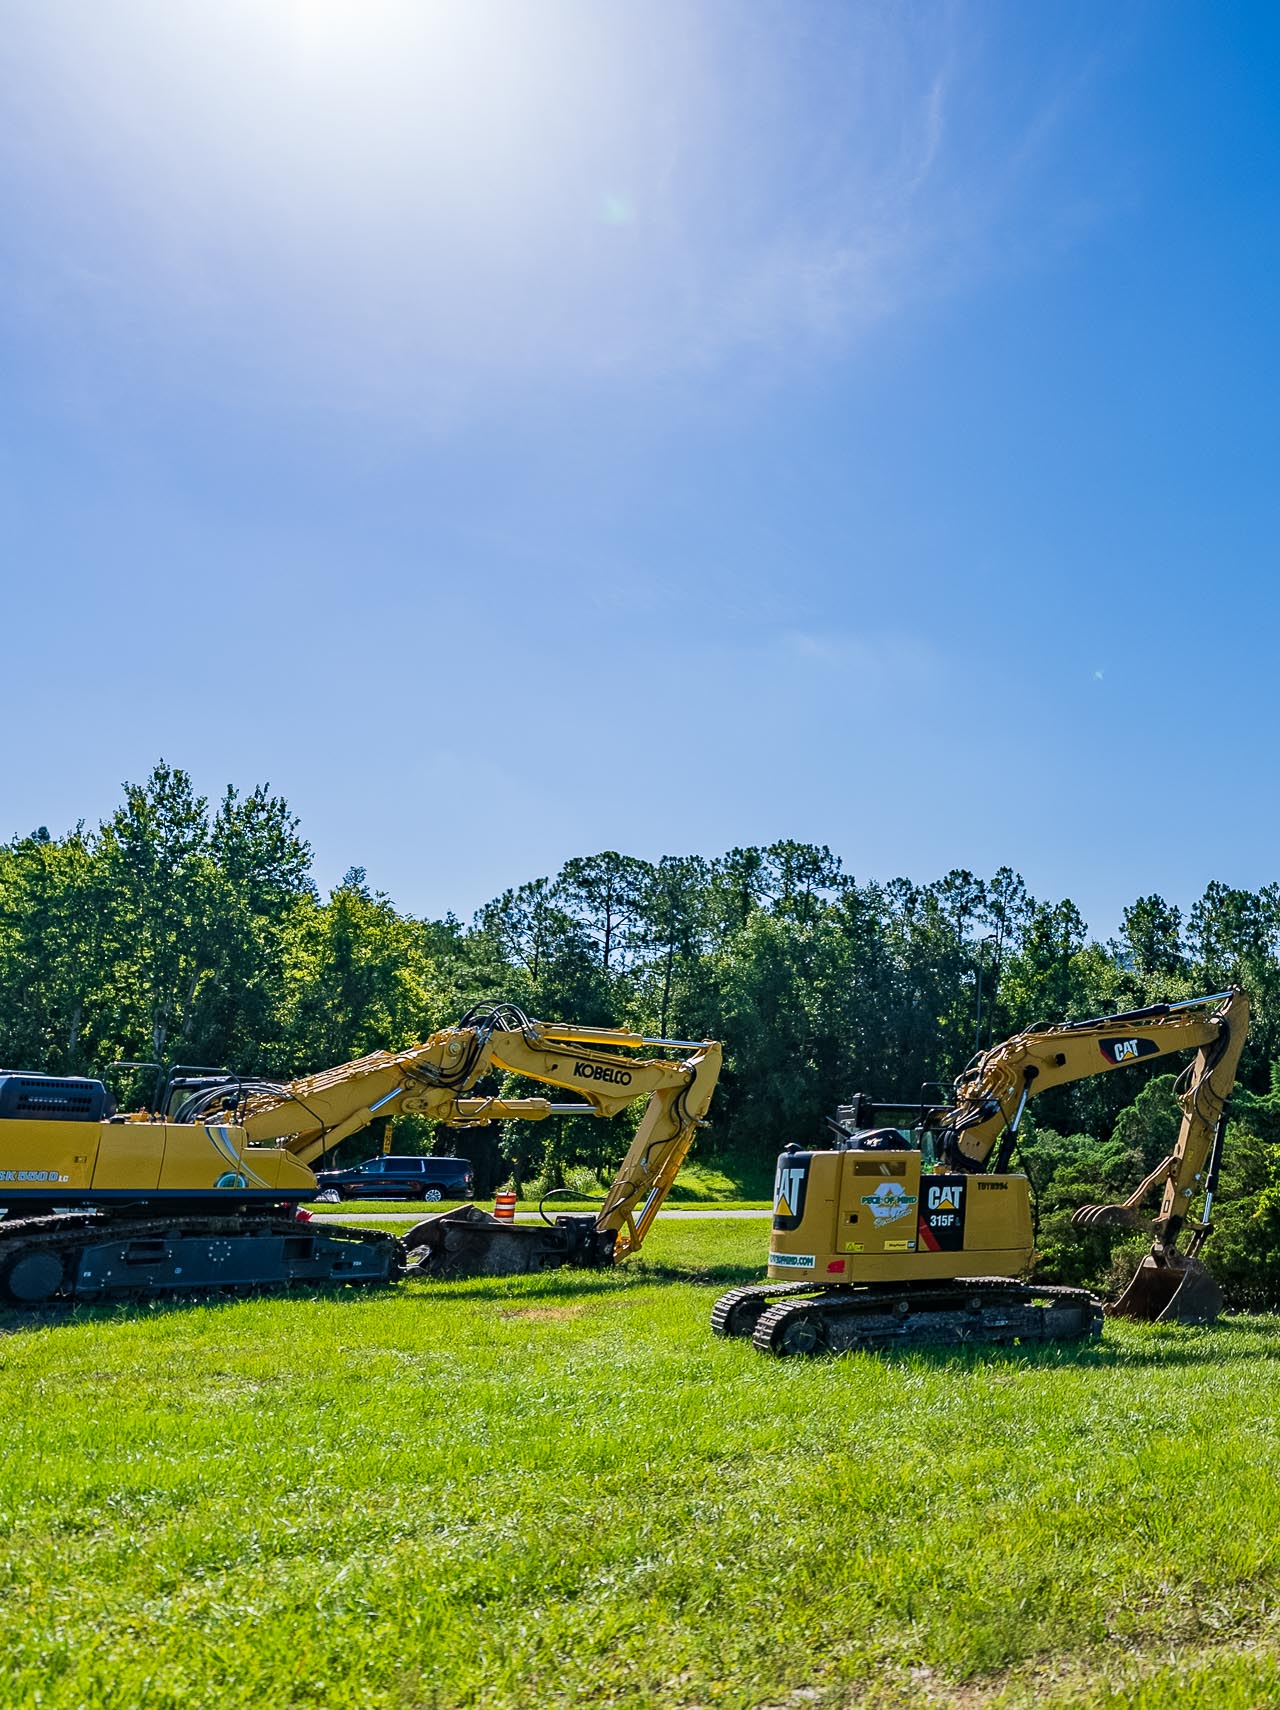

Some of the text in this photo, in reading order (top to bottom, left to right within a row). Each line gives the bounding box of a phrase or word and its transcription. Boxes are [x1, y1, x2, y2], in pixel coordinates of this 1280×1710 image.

[1114, 1039, 1139, 1062] CAT
[573, 1061, 632, 1086] KOBELCO
[927, 1186, 963, 1210] CAT
[929, 1214, 954, 1227] 315F
